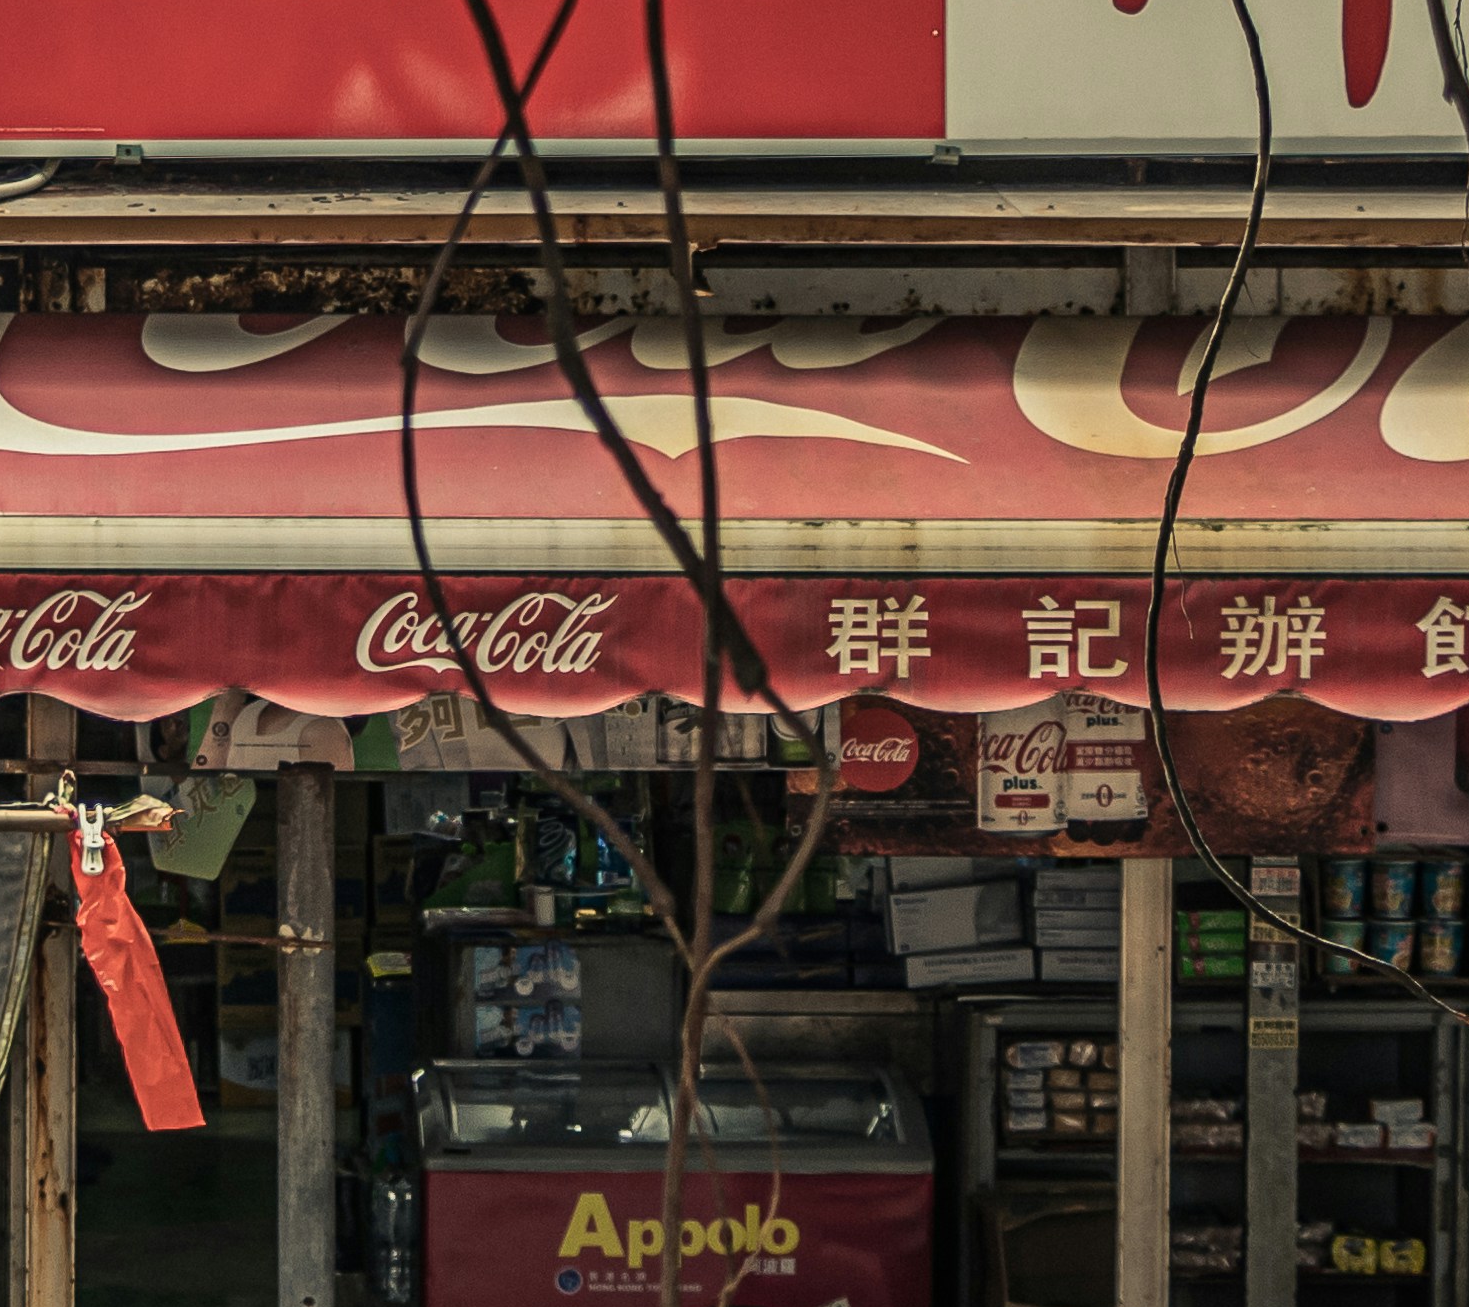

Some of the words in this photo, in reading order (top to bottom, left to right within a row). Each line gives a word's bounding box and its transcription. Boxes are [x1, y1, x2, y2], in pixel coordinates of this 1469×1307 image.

[355, 591, 619, 675] Coca-Cola
[1086, 714, 1119, 728] plus
[841, 737, 915, 762] Coca-Cola
[1003, 776, 1038, 792] plus
[559, 1192, 801, 1269] Appolo
